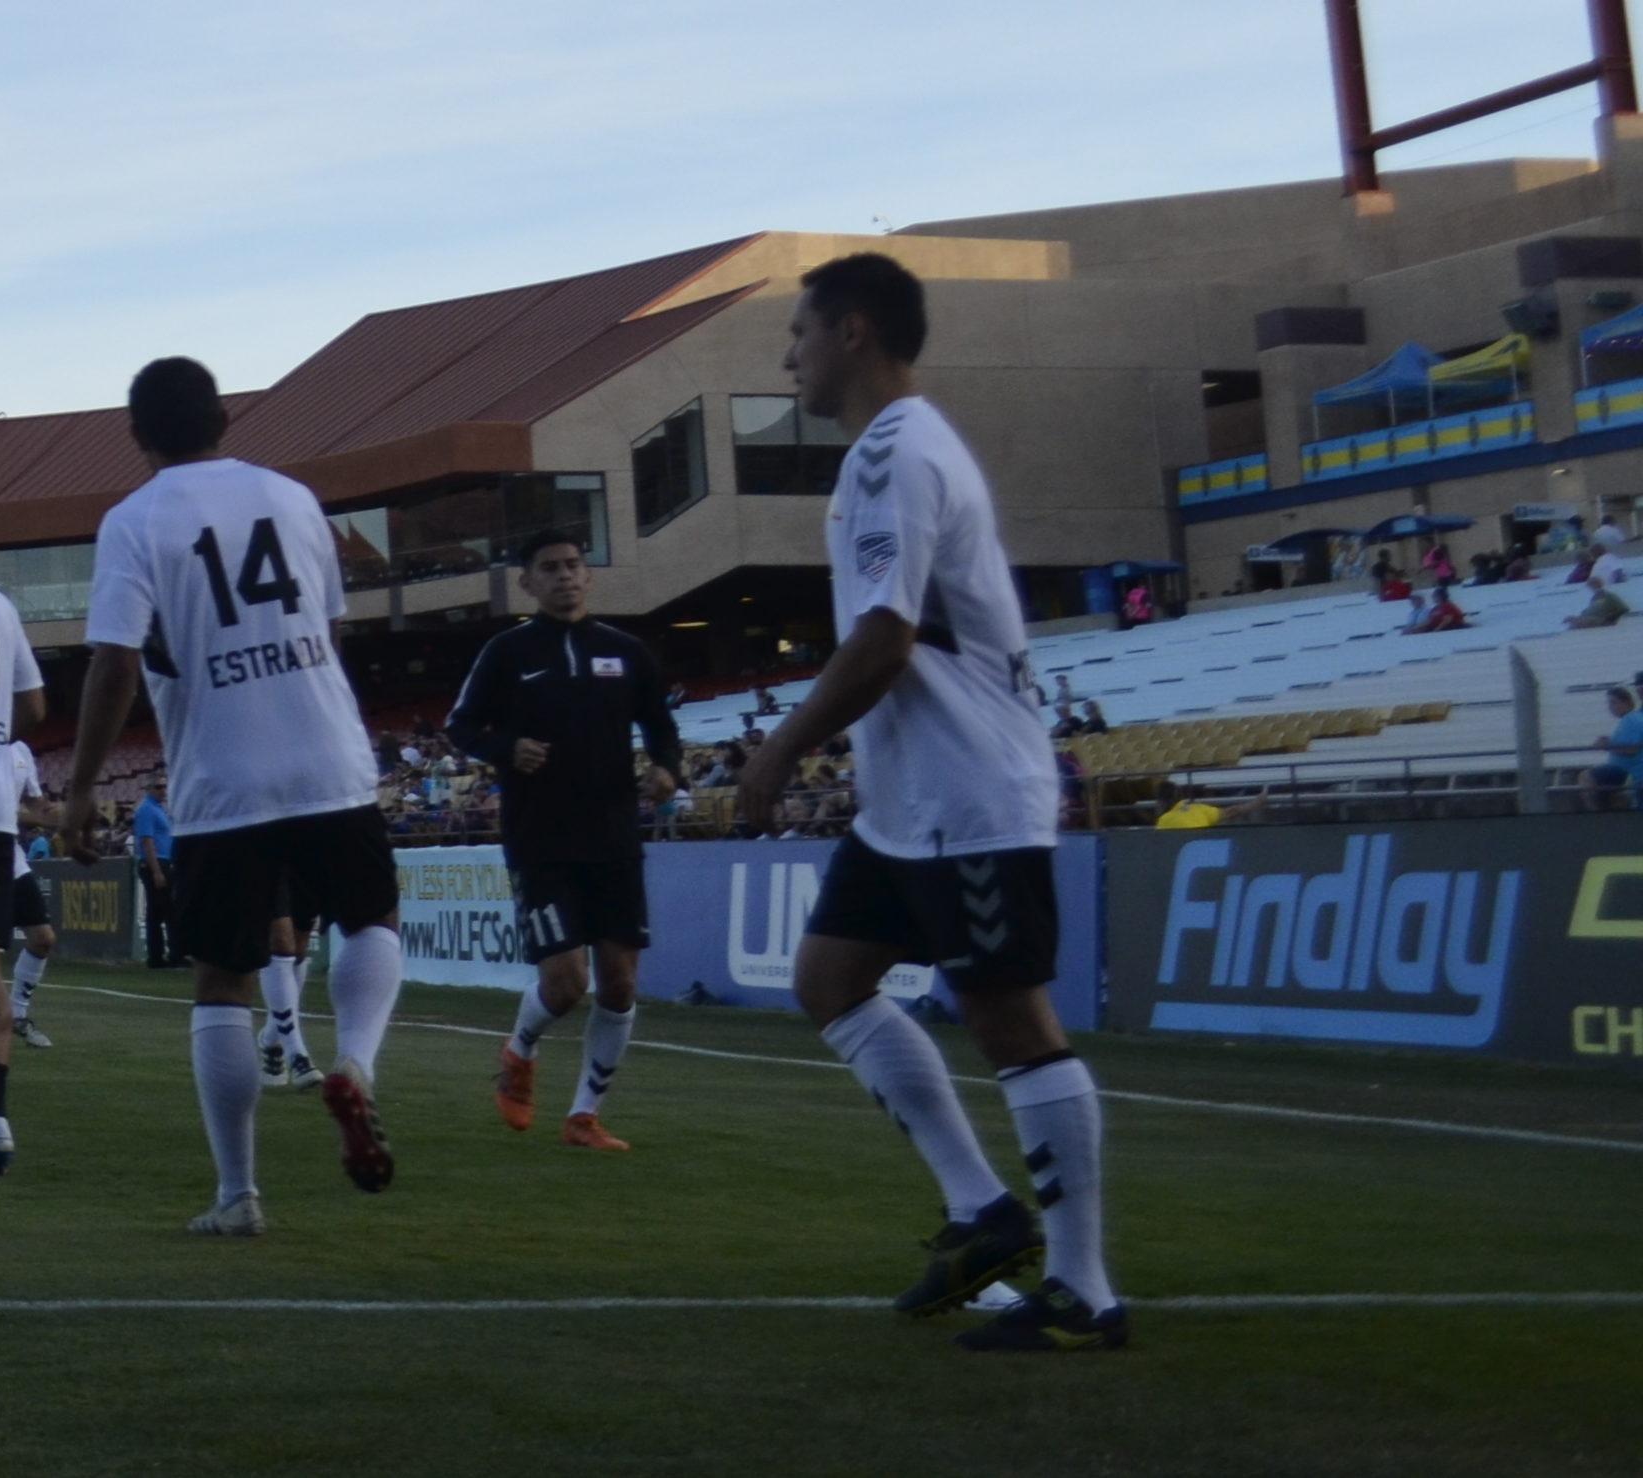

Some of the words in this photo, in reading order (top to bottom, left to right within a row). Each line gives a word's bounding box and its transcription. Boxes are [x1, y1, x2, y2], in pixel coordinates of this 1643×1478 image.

[193, 518, 302, 628] 14
[529, 903, 566, 947] 11
[1150, 833, 1524, 1048] Findlay
[883, 974, 919, 987] NTER
